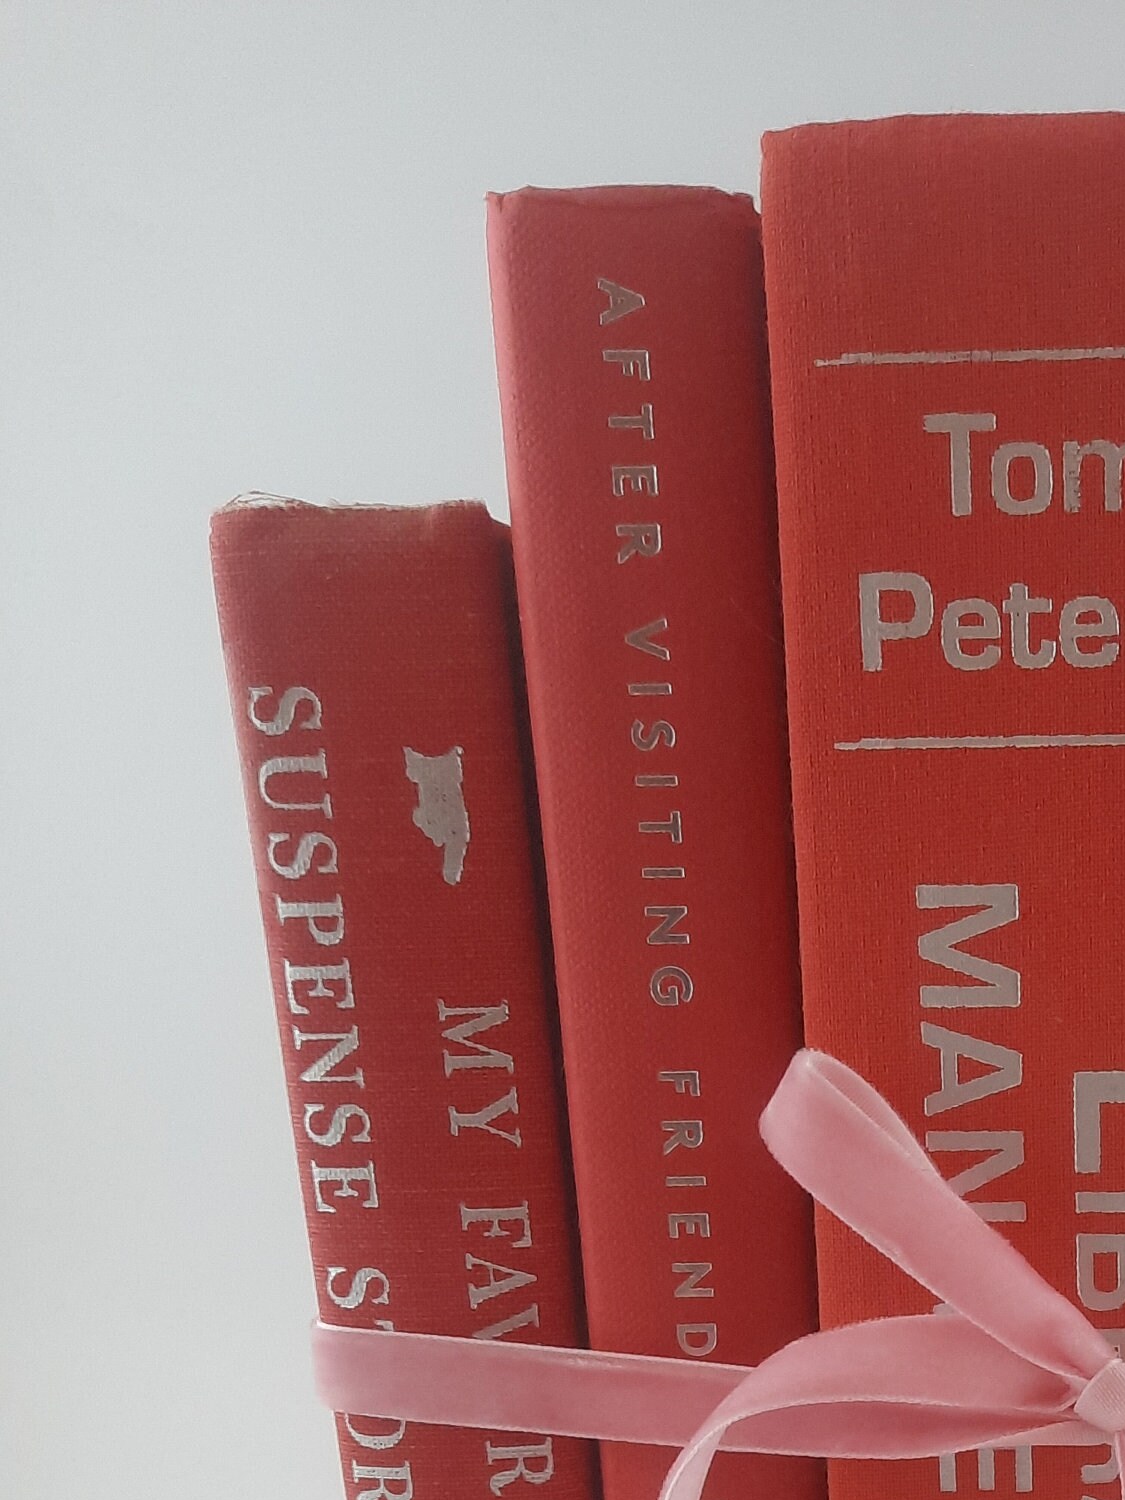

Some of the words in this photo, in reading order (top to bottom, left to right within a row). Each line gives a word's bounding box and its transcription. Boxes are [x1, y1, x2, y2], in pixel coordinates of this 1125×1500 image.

[597, 278, 662, 564] AFTER
[248, 686, 379, 1213] SUSPENSE
[625, 618, 693, 1007] VISITING
[438, 1000, 521, 1147] MY
[658, 1070, 717, 1358] FRIEND
